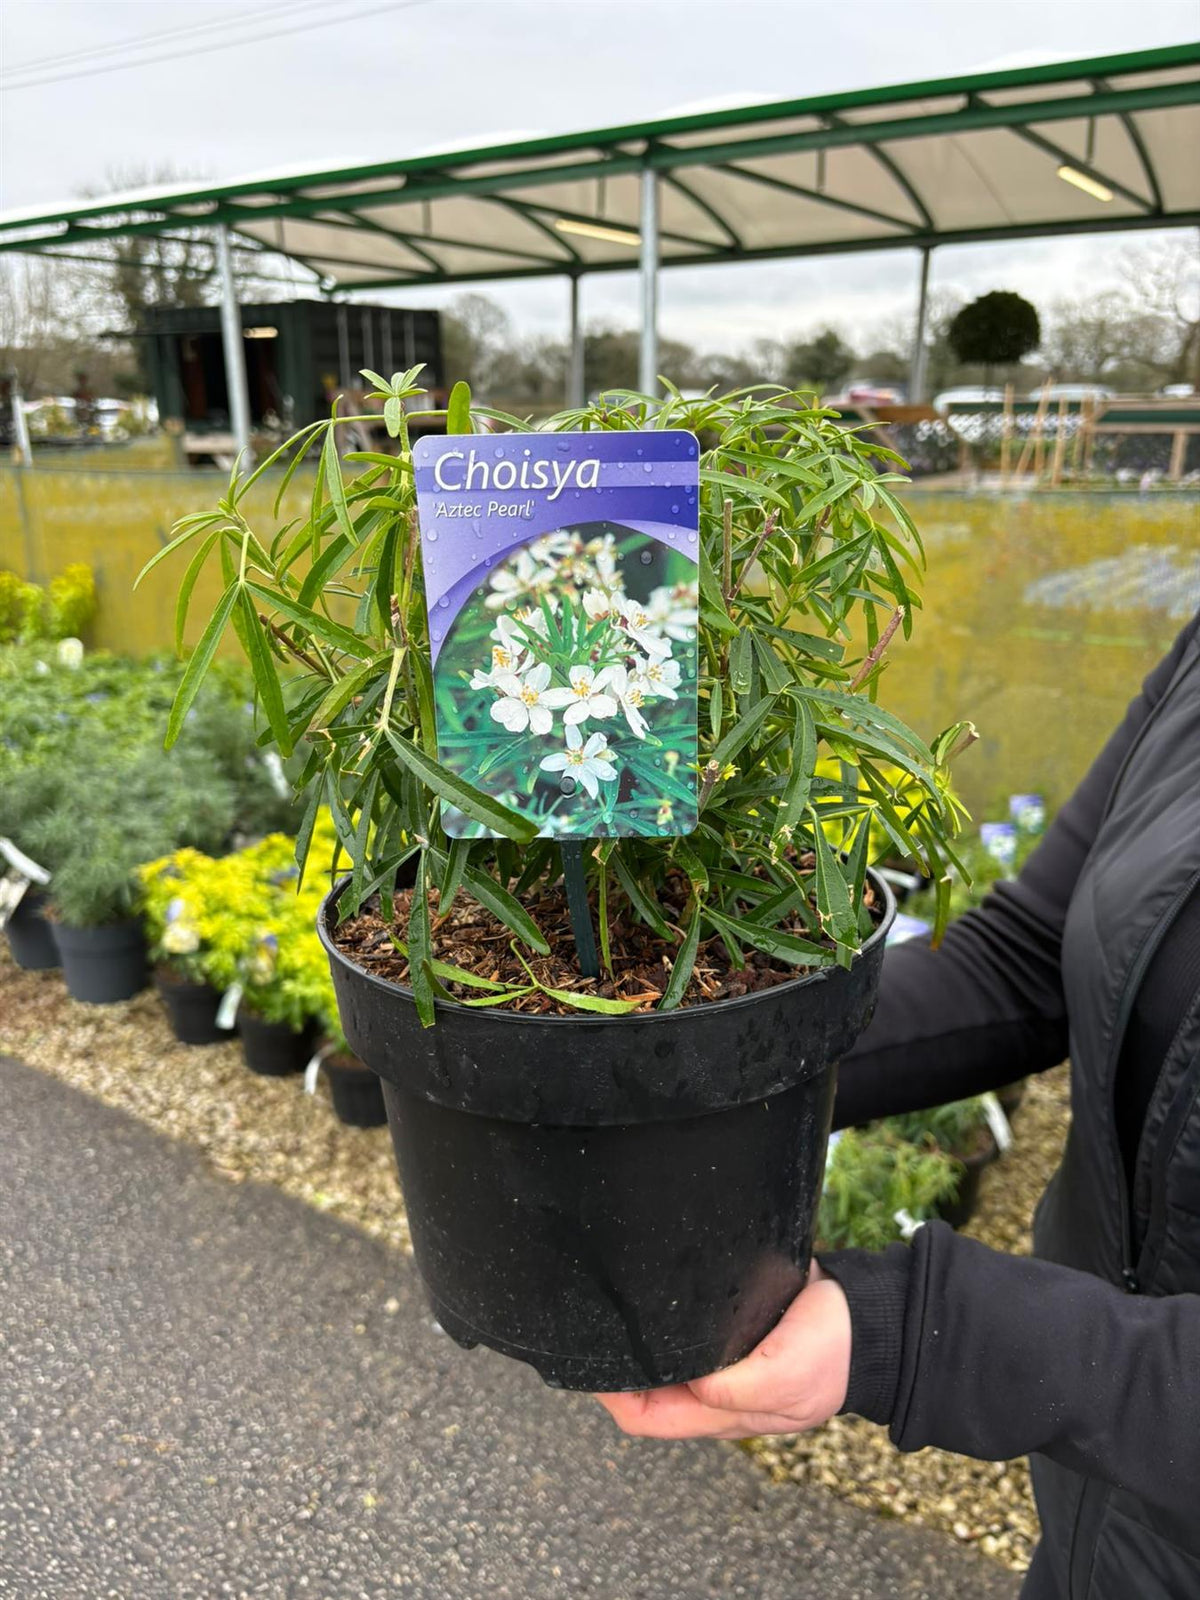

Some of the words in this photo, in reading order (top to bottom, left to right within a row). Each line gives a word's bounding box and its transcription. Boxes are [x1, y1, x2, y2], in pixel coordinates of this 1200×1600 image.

[433, 450, 601, 500] Choisya
[432, 502, 482, 518] 'Aztec
[487, 501, 535, 518] Pearl'
